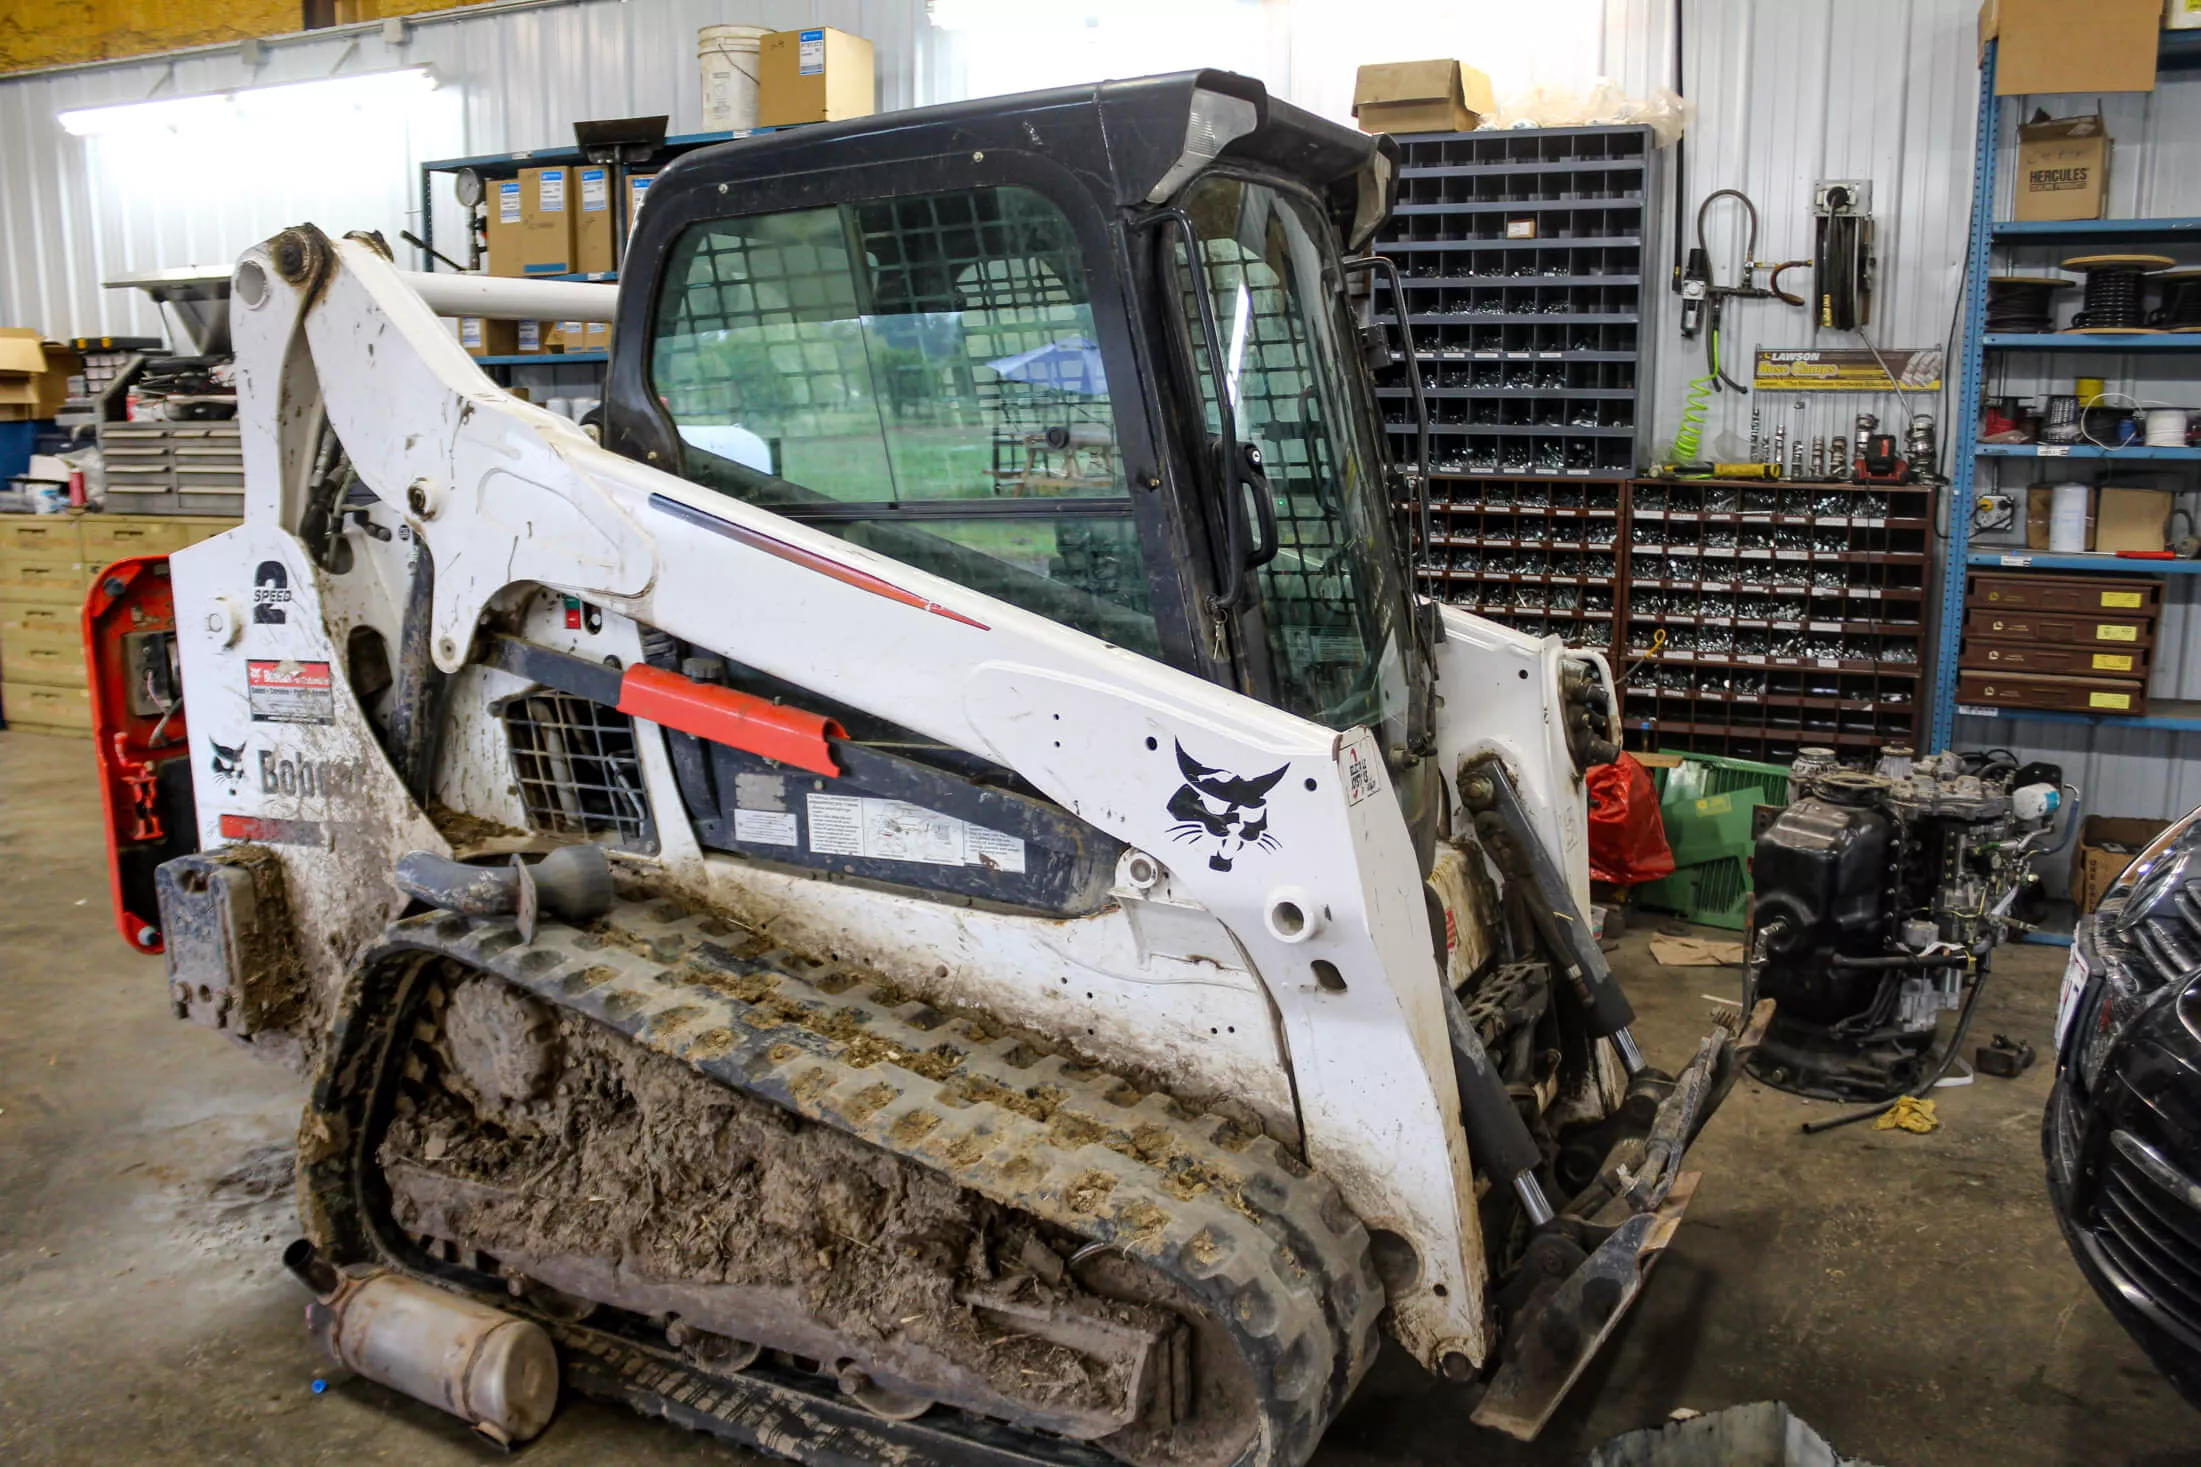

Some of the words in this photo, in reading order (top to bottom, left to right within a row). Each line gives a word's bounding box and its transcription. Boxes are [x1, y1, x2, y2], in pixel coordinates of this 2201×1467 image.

[2030, 168, 2087, 182] HERCULES
[1771, 352, 1820, 361] LAWSON
[253, 560, 288, 625] 2
[254, 590, 292, 602] SPEED
[258, 750, 361, 798] Bobct
